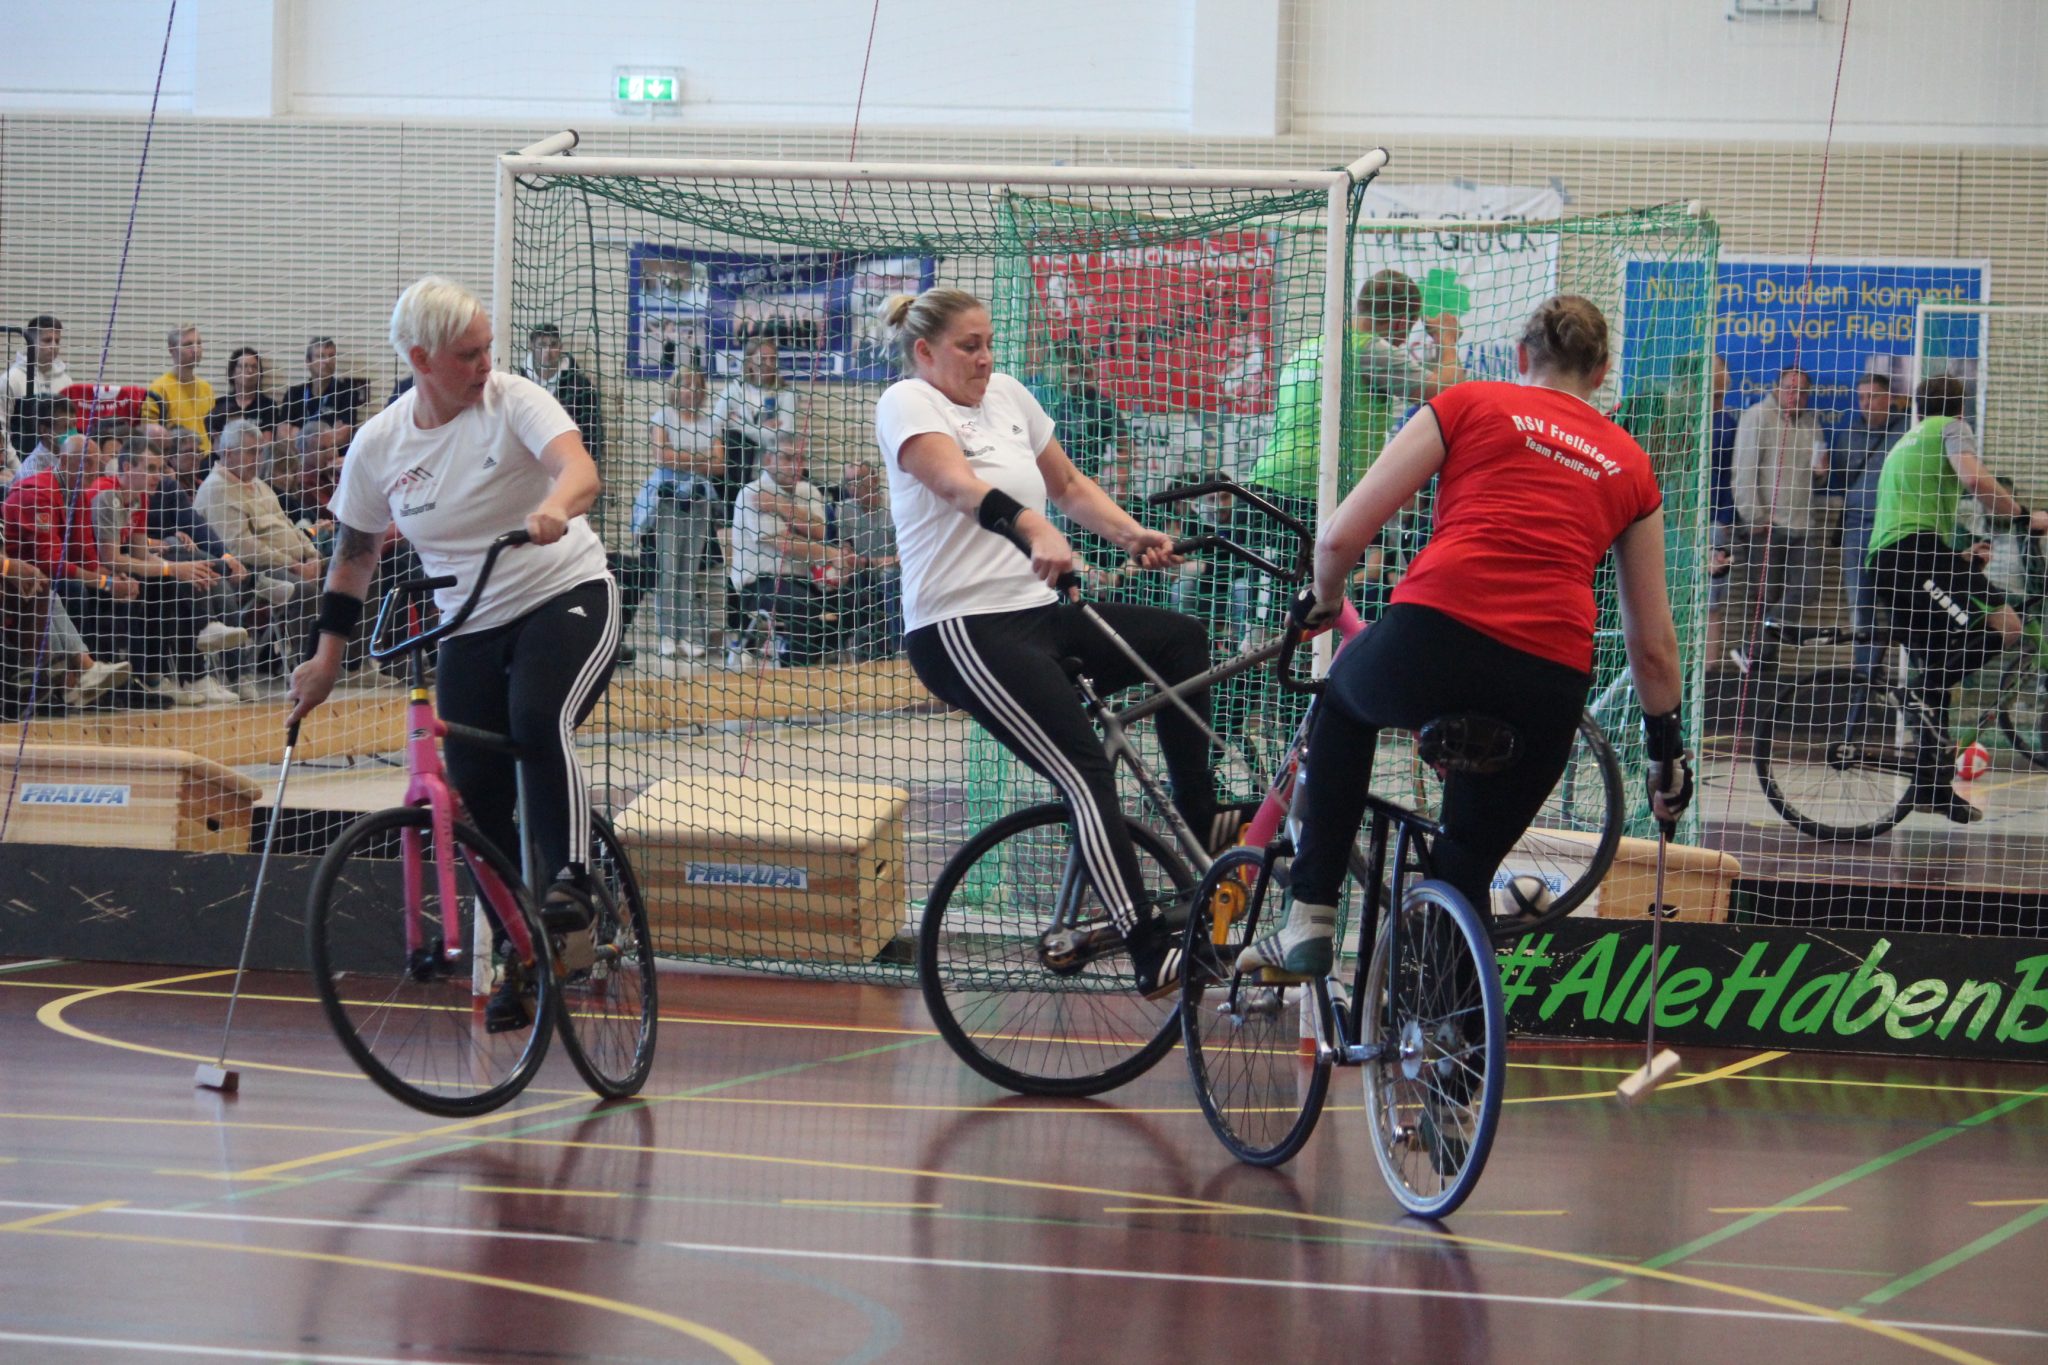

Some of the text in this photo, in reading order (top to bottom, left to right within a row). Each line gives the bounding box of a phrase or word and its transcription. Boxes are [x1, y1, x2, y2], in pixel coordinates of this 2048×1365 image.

[1755, 279, 1849, 306] Duden
[1788, 318, 1836, 339] vor
[1846, 314, 1913, 342] Fleiß
[1512, 415, 1621, 476] RSV Frellstedt
[1525, 435, 1600, 481] Team FrellFeld
[21, 786, 125, 804] FRATUFA
